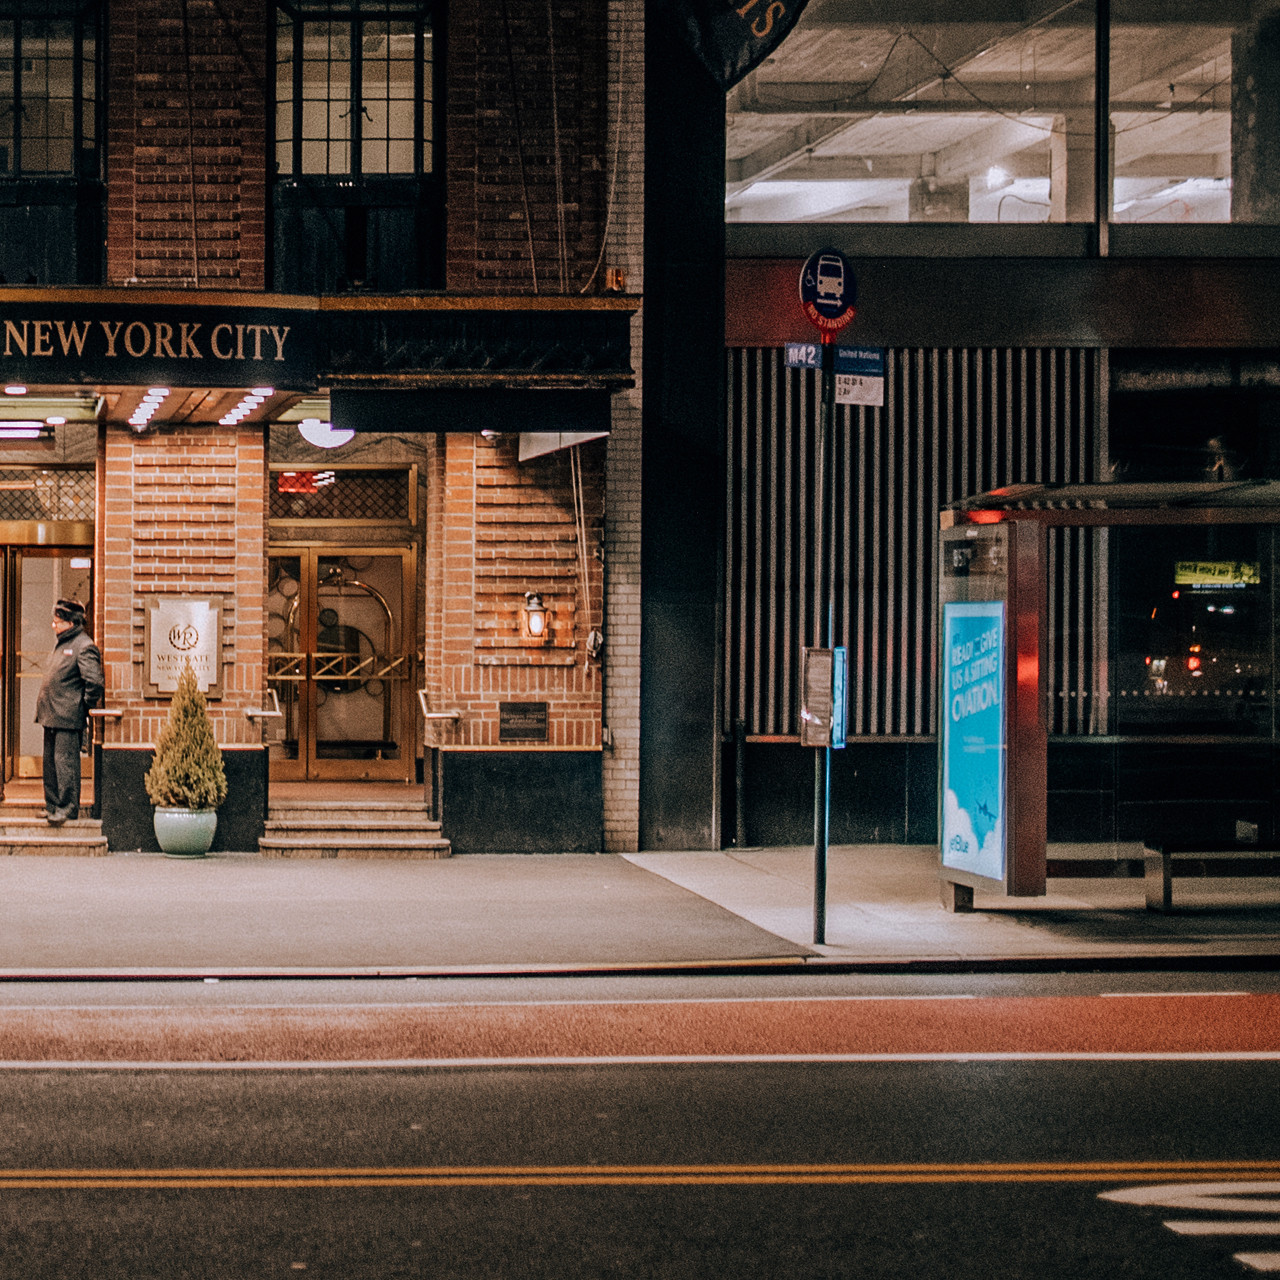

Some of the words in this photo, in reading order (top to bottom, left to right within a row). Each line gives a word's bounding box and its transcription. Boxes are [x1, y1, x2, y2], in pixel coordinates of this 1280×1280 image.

[807, 303, 818, 319] NO
[817, 308, 855, 329] STANDING
[3, 320, 92, 357] NEW
[99, 321, 203, 359] YORK
[211, 323, 291, 361] CITY
[788, 345, 816, 364] M42
[952, 668, 963, 690] US
[970, 651, 998, 682] SITTING
